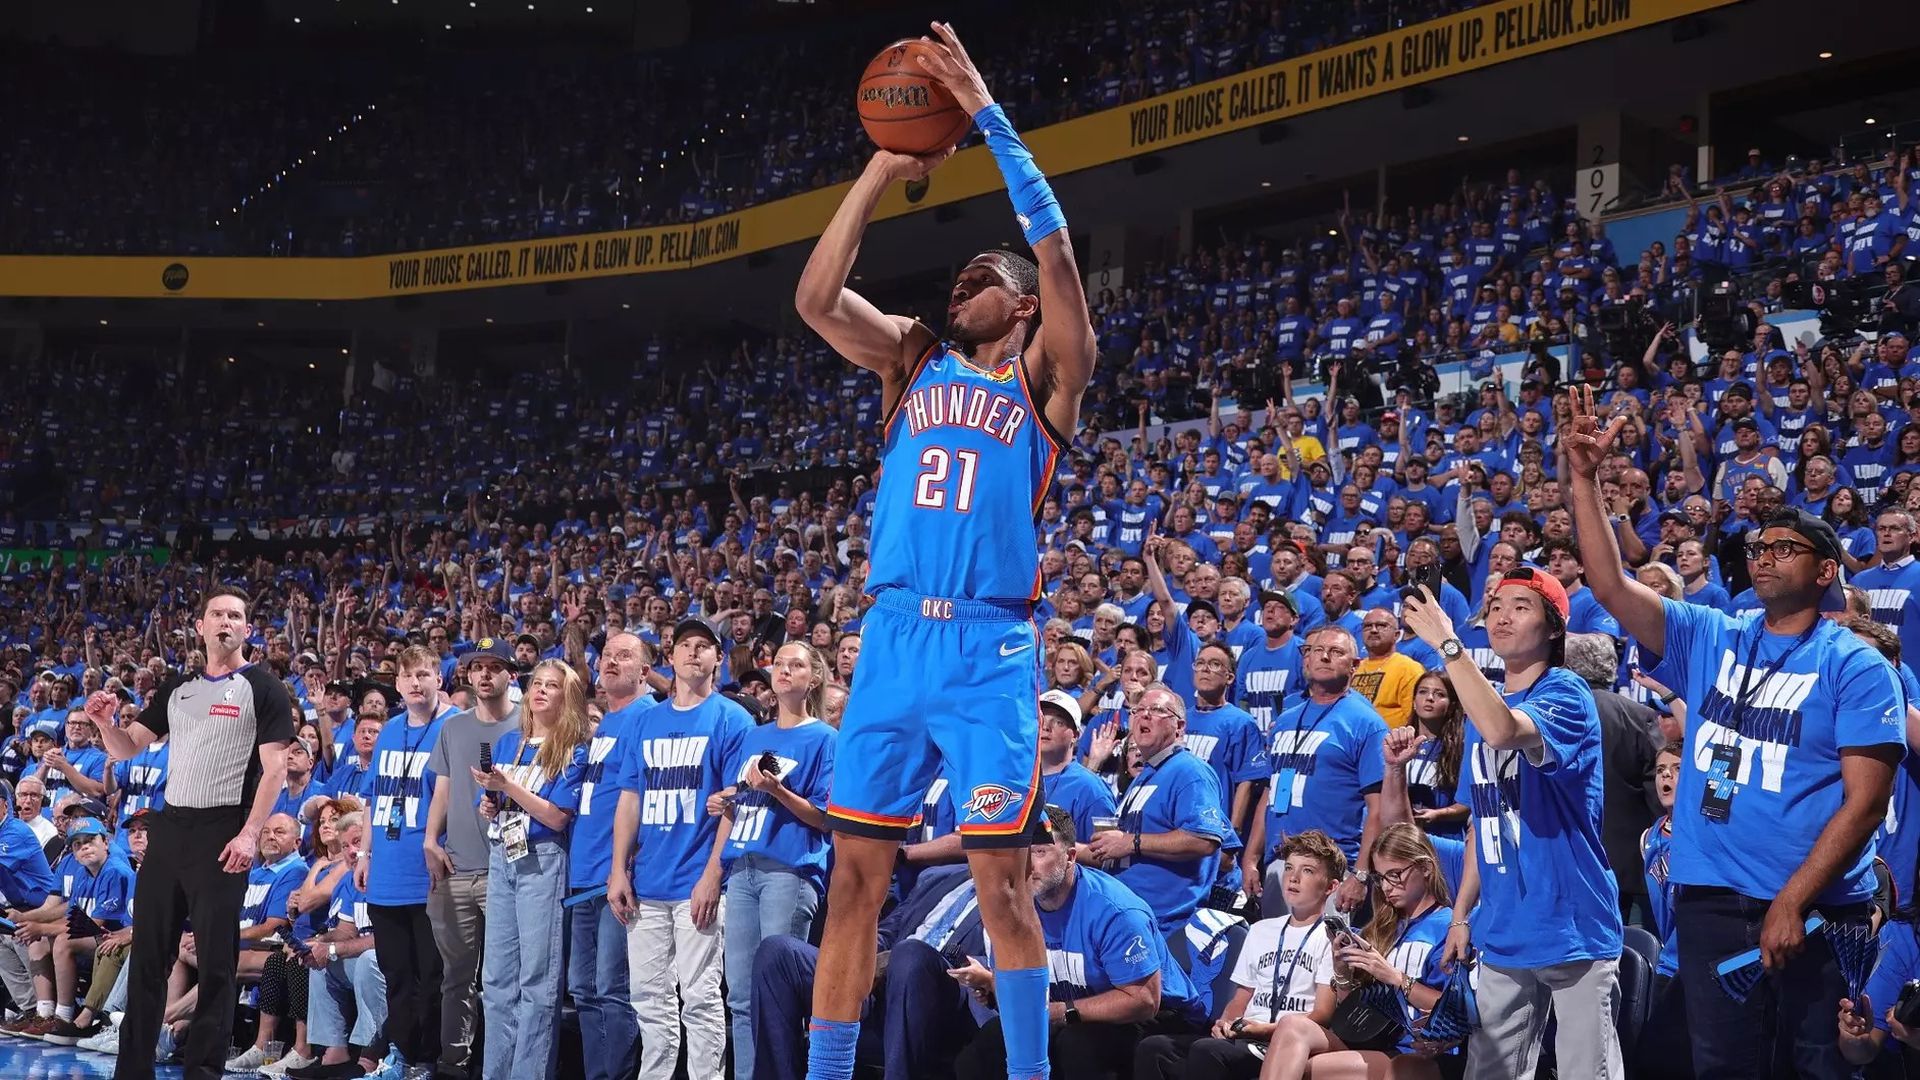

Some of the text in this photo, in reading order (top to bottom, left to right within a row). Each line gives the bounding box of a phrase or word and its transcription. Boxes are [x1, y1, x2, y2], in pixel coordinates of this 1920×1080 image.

[1130, 103, 1168, 147] YOUR
[1173, 88, 1224, 136] HOUSE
[1229, 71, 1291, 121] CALLED.
[1298, 63, 1312, 104] IT
[1318, 46, 1377, 98] WANTS
[1383, 41, 1394, 82] A
[1401, 25, 1452, 77] GLOW
[1458, 18, 1487, 62] UP.
[389, 219, 740, 289] YOUR HOUSE CALLED. IT WANTS A GLOW UP. PELLAOK.COM
[904, 383, 1027, 447] THUNDER
[914, 445, 980, 513] 21
[922, 598, 954, 620] OKC
[1246, 670, 1289, 693] LOUD
[1715, 648, 1820, 710] LOUD
[210, 706, 239, 716] Emirates
[643, 736, 709, 768] LOUD
[372, 795, 420, 828] CIY
[642, 788, 697, 824] CITY
[971, 792, 1003, 811] OKC
